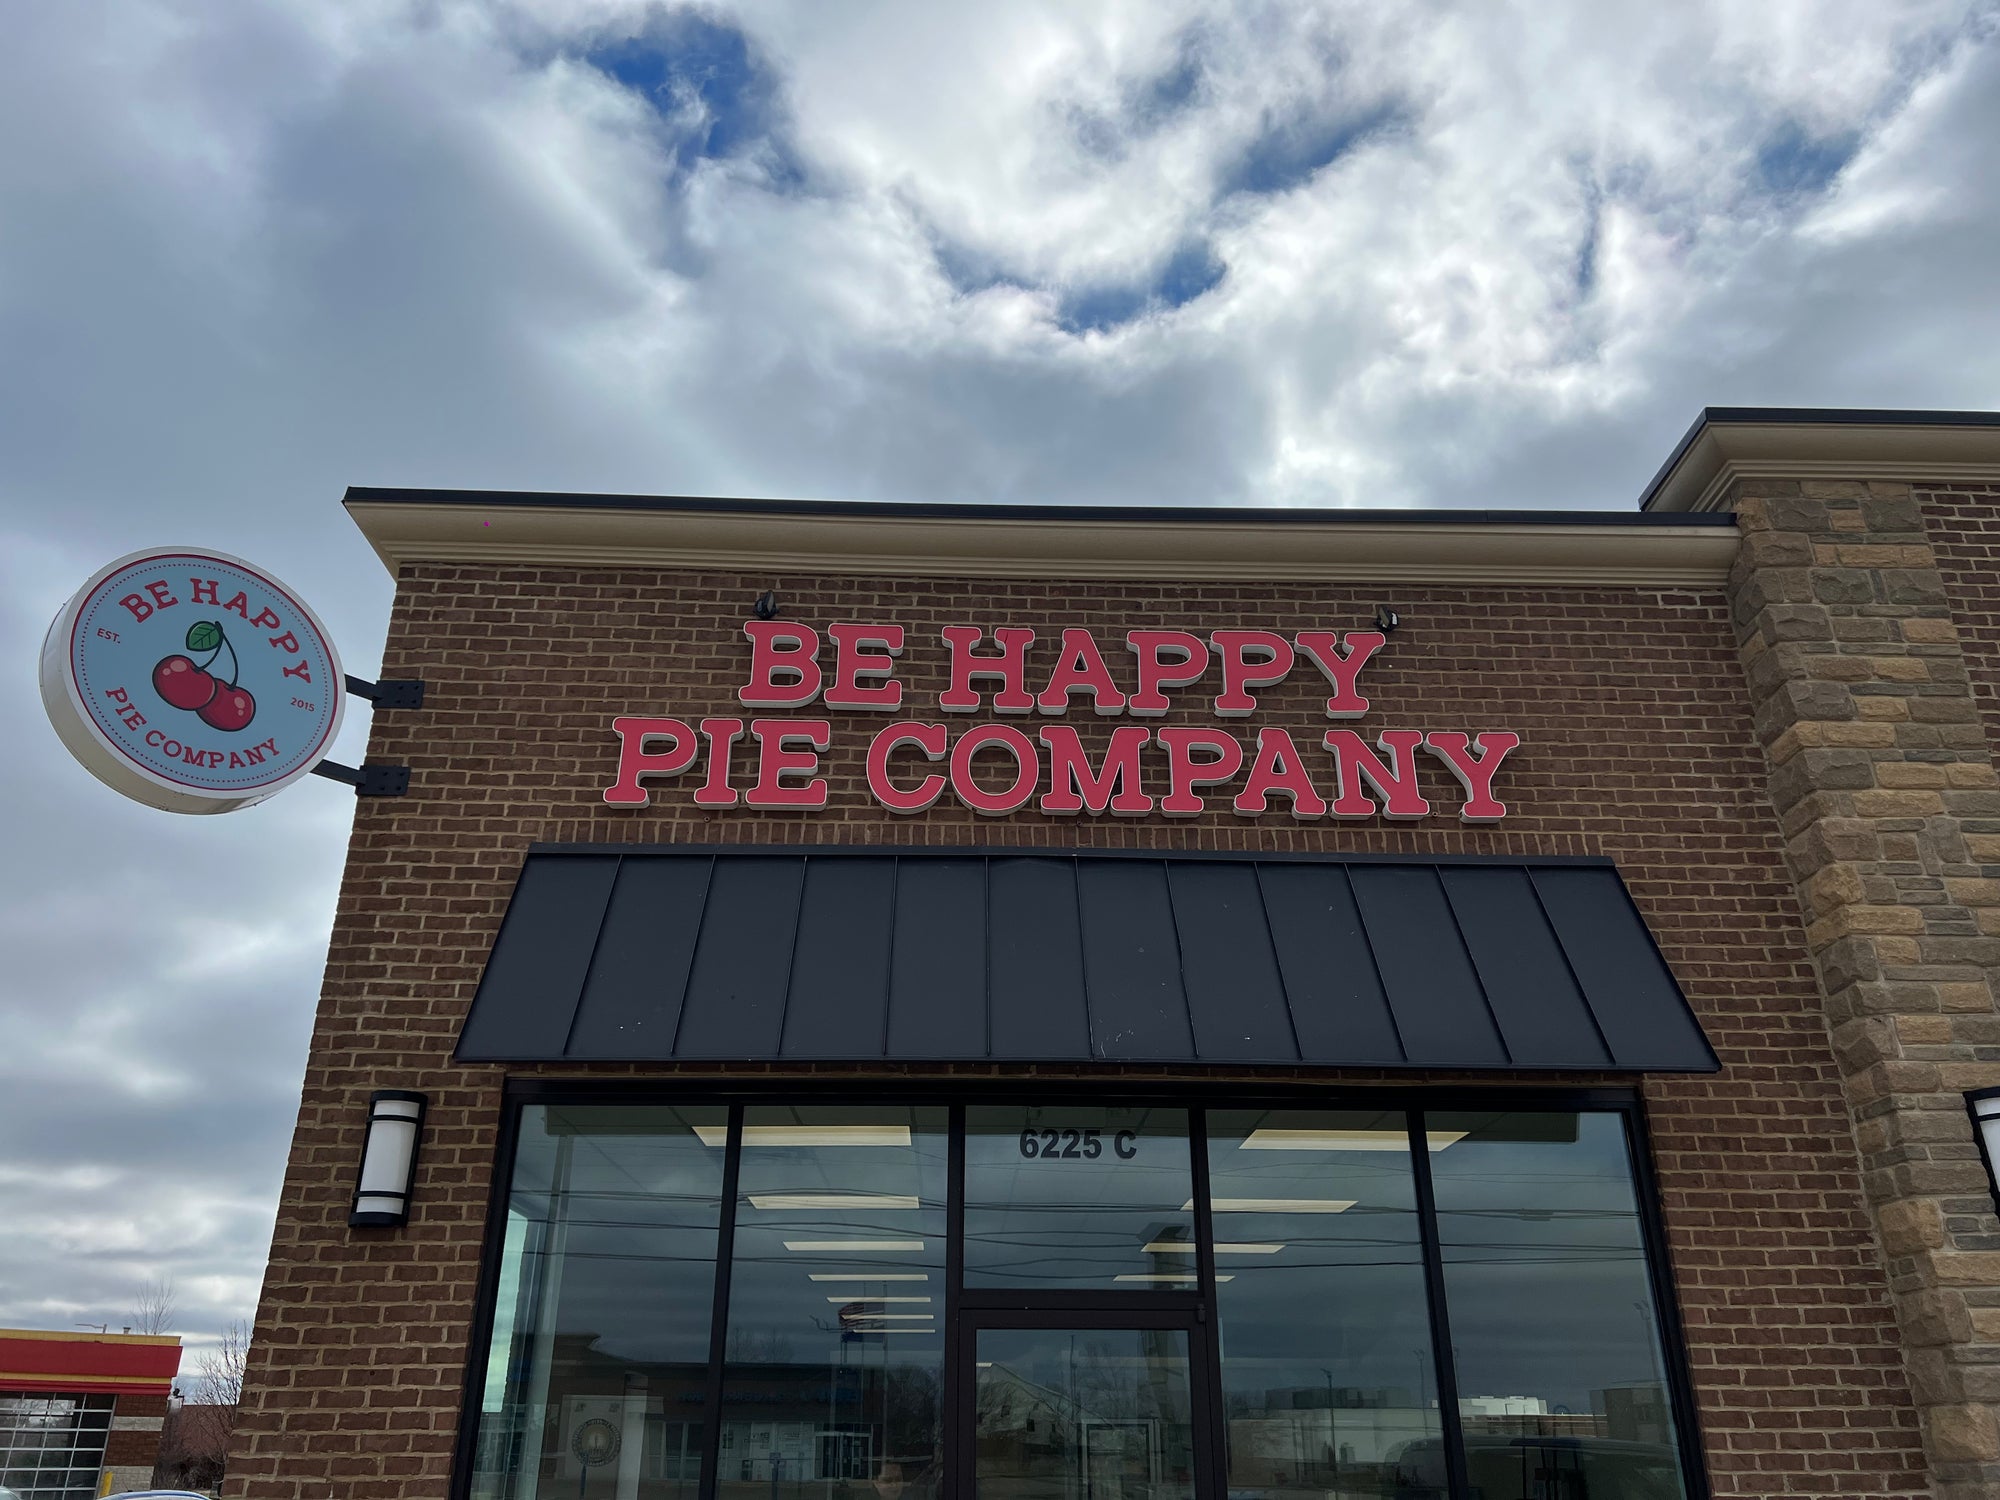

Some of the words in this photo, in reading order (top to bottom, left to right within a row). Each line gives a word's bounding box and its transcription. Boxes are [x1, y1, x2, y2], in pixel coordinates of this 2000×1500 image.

[96, 627, 121, 645] EST.
[119, 579, 179, 624] BE
[190, 577, 312, 684] HAPPY
[738, 620, 904, 712] BE
[939, 626, 1386, 719] HAPPY
[105, 686, 148, 732] PIE
[145, 730, 280, 769] COMPANY
[290, 697, 315, 712] 2015
[603, 717, 830, 811] PIE
[866, 721, 1520, 824] COMPANY
[1019, 1128, 1103, 1159] 6225
[1114, 1129, 1137, 1160] C
